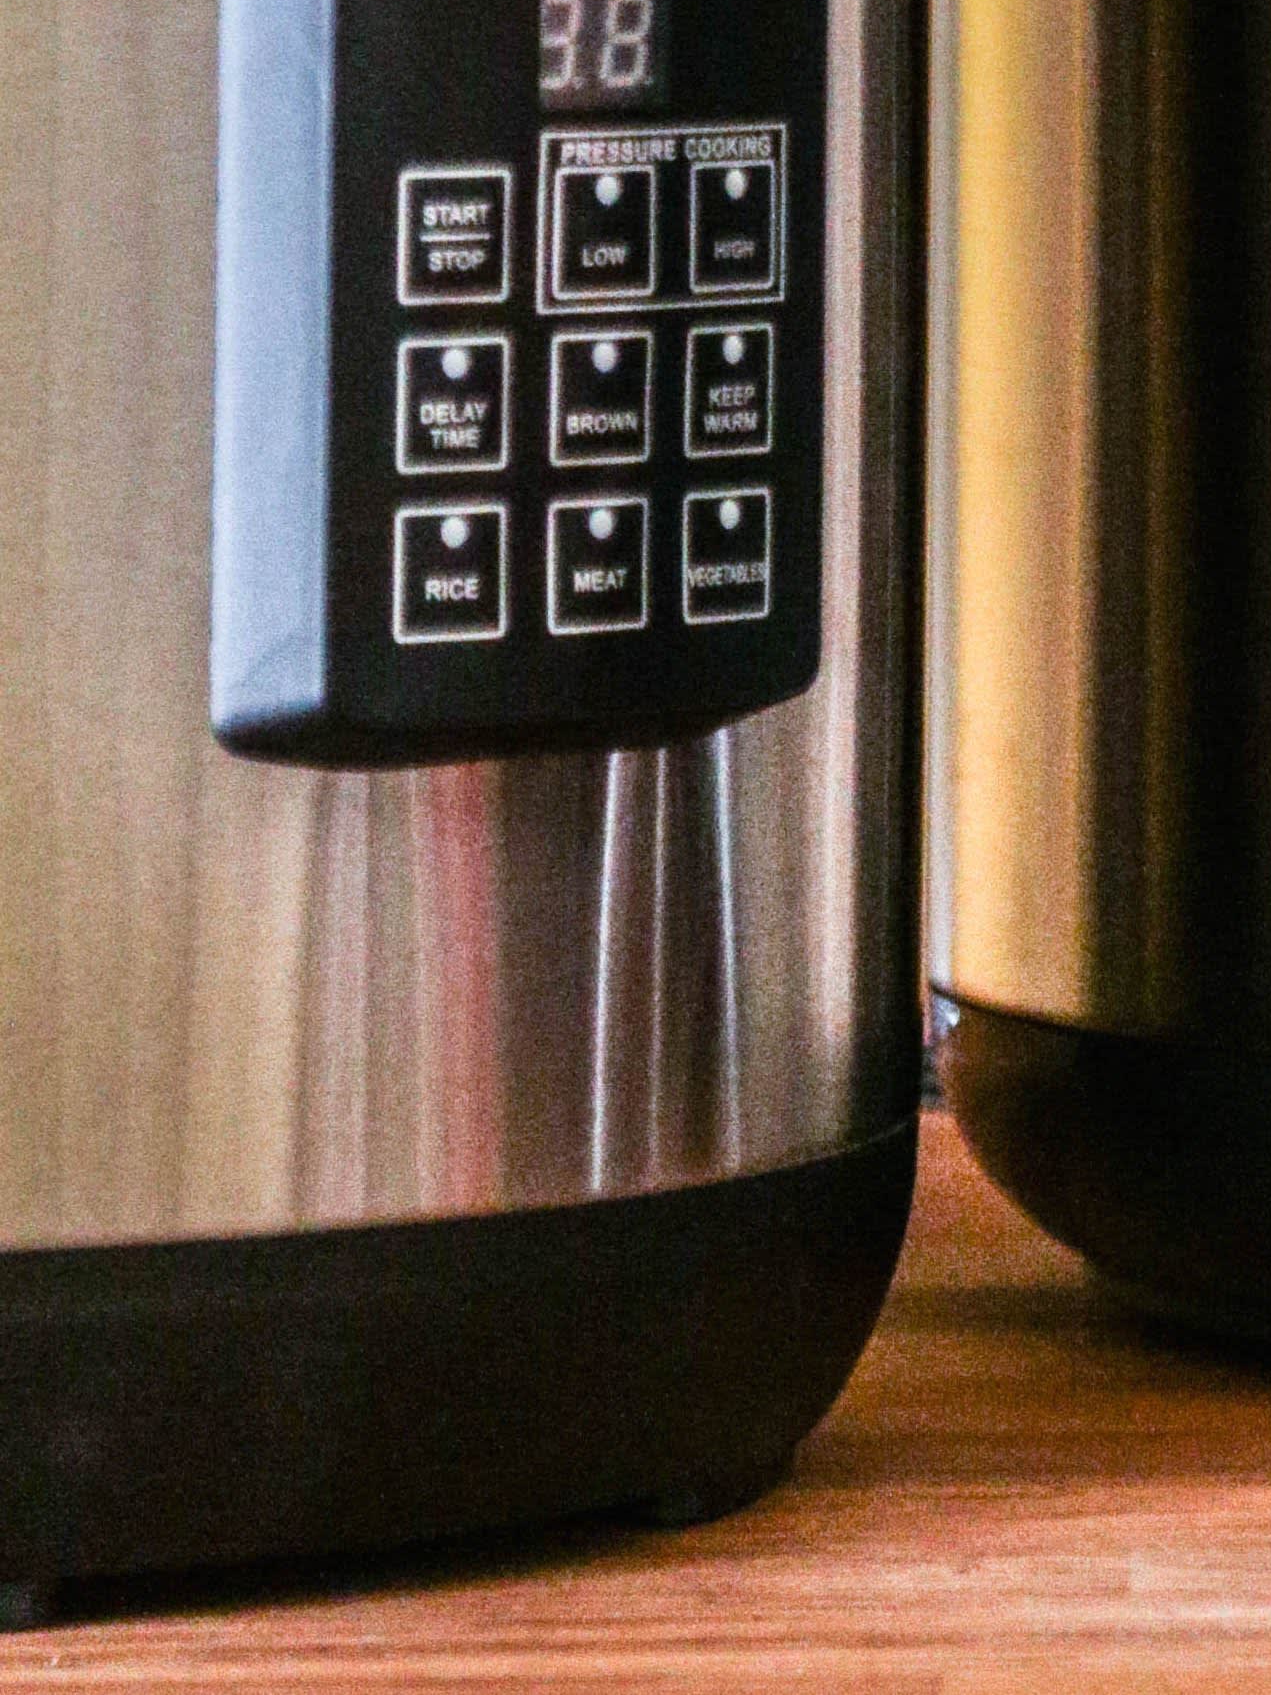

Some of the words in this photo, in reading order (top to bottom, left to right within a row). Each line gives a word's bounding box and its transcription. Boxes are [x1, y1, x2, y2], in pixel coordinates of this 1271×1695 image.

[561, 140, 675, 165] PRESSURE
[685, 136, 772, 161] COOKING
[423, 203, 489, 226] START
[428, 249, 487, 272] STOP
[581, 245, 628, 268] LOW
[713, 240, 755, 260] HIGH
[708, 385, 755, 407] KEEP
[420, 402, 487, 425] DELAY
[566, 413, 638, 435] BROWN
[703, 411, 757, 434] WARM
[431, 428, 481, 449] TIME
[573, 569, 627, 593] MEAT
[687, 562, 766, 588] VEGETABLES
[425, 578, 480, 602] RICE
